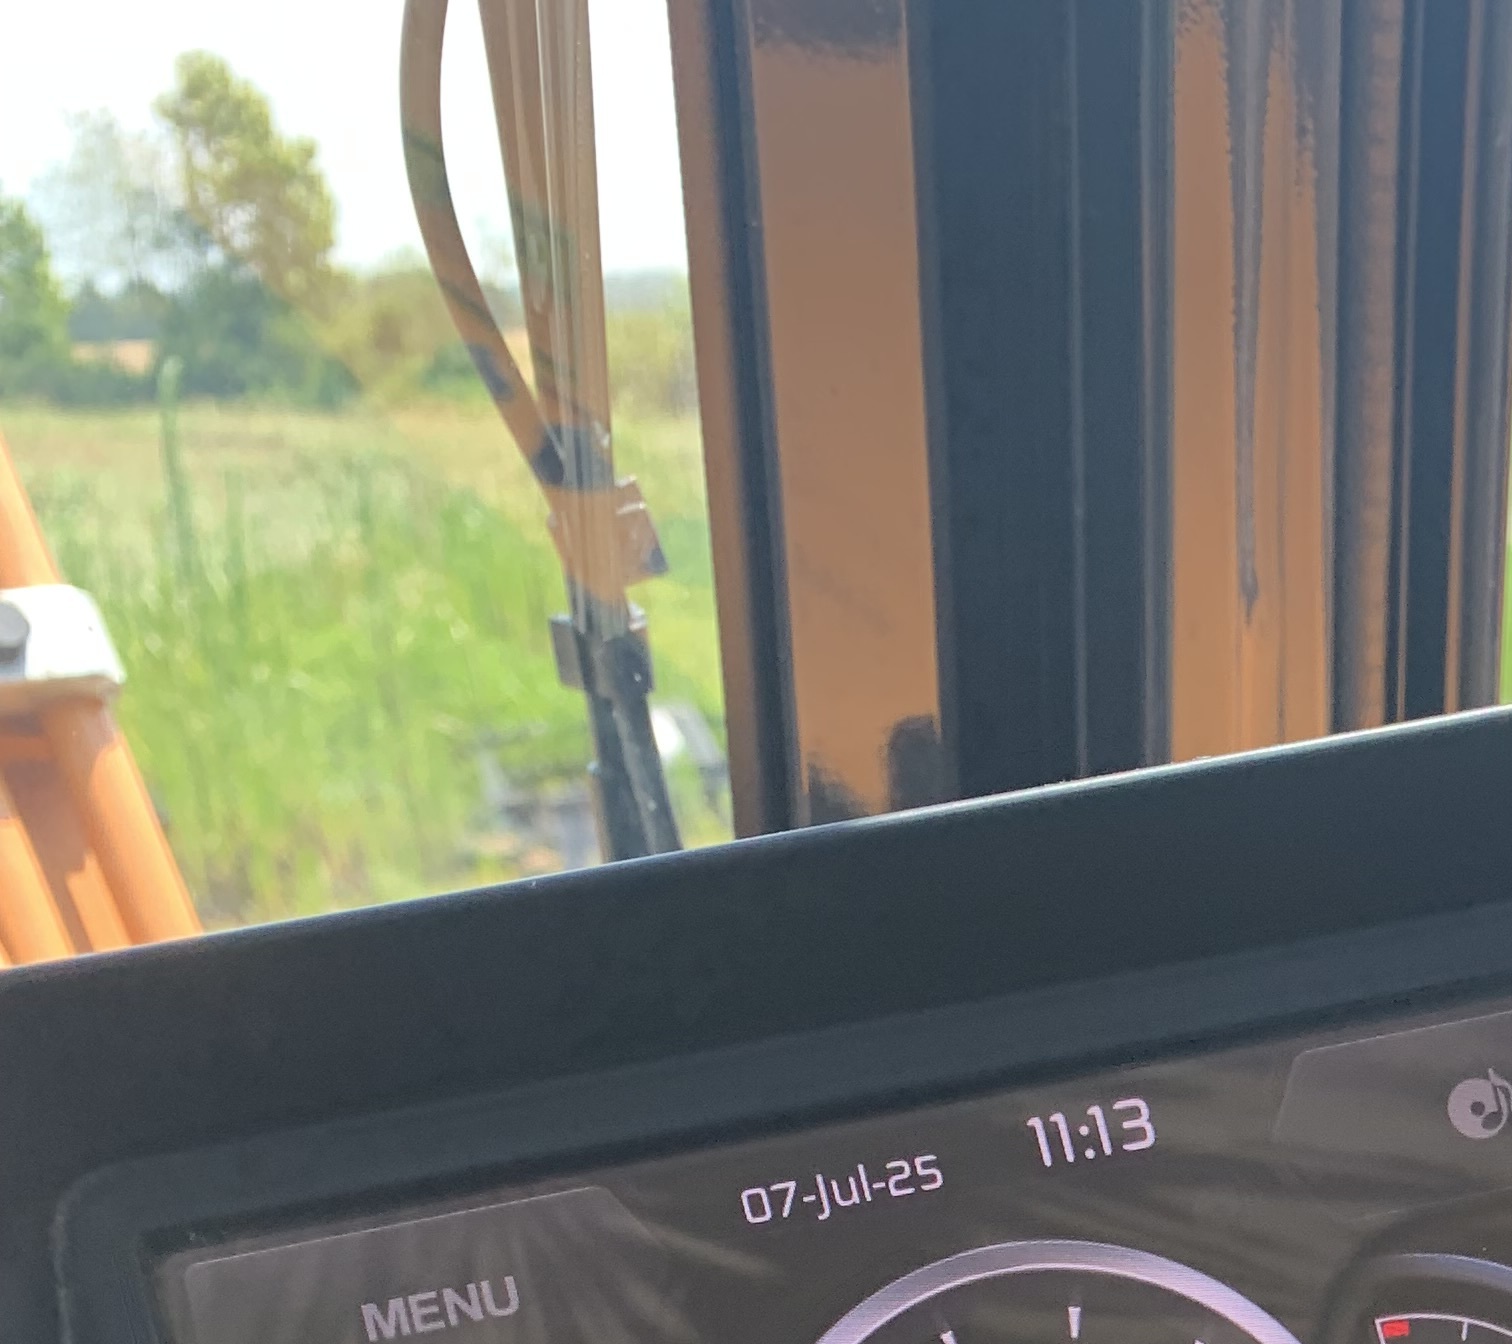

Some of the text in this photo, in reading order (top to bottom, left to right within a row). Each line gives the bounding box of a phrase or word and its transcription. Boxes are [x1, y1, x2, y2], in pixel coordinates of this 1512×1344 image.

[1027, 1098, 1156, 1167] 11:13
[741, 1154, 944, 1223] 07-Jul-25
[361, 1275, 520, 1342] MENU
